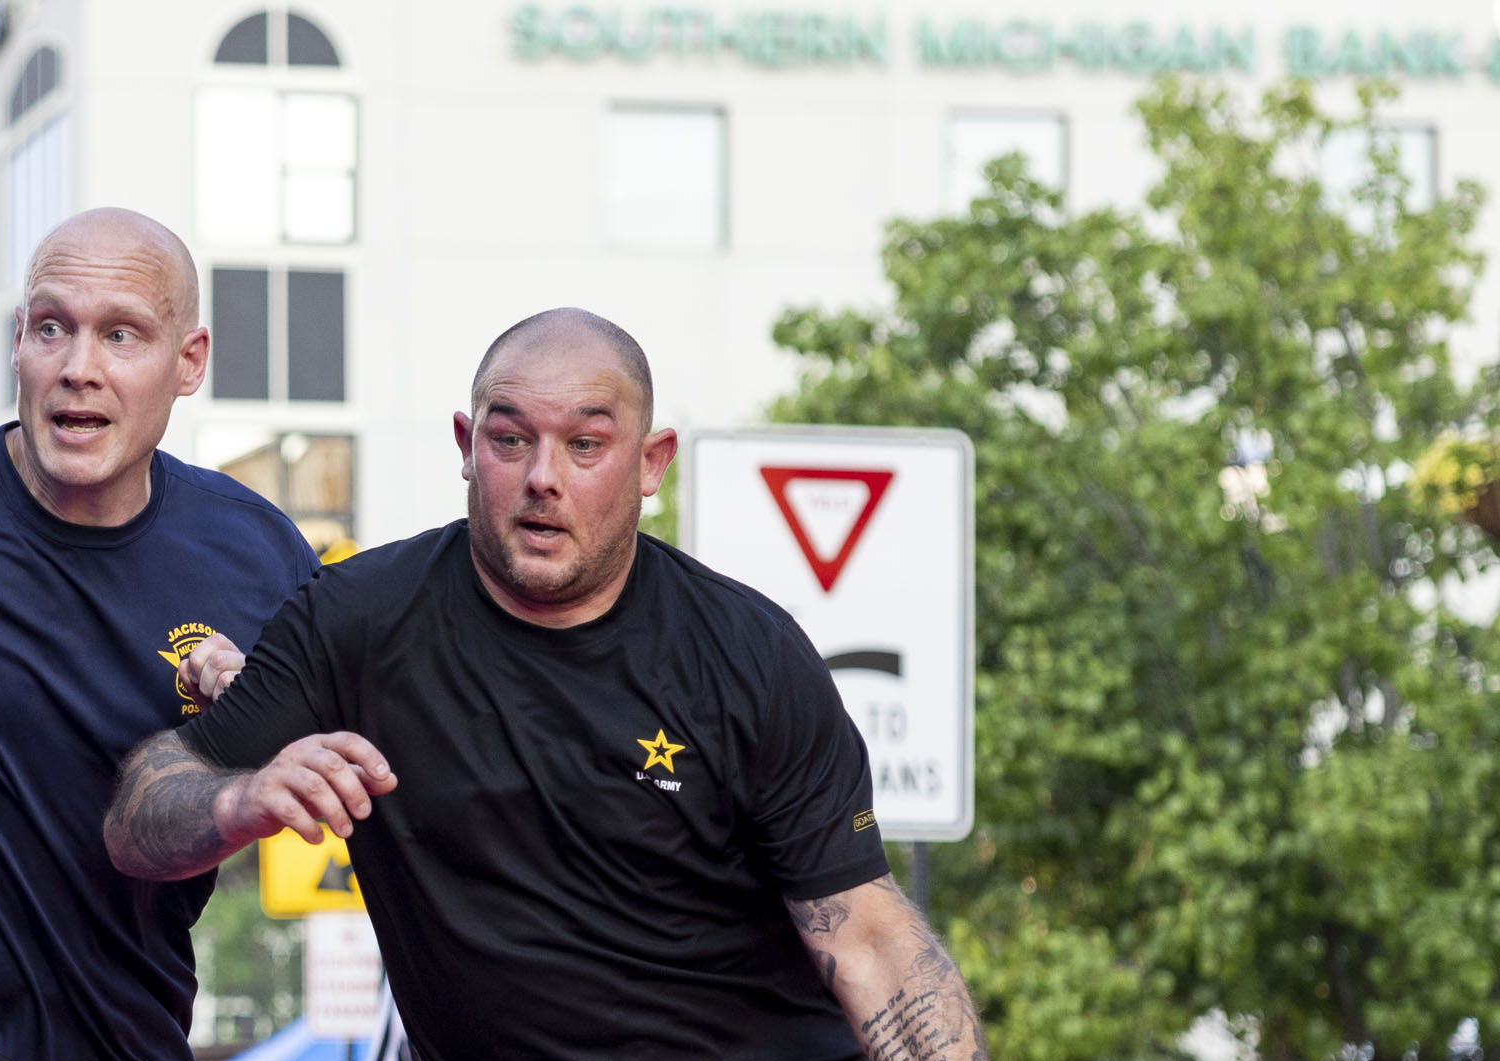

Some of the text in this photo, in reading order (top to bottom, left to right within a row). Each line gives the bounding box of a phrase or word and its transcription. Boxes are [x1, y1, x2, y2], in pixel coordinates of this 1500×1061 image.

[509, 3, 1464, 79] SOUTHERN MICHIGAN BANK
[168, 623, 216, 643] JACKSO
[181, 704, 200, 715] POS
[866, 703, 908, 744] TO
[653, 779, 681, 791] ARMY
[877, 758, 943, 799] ANS
